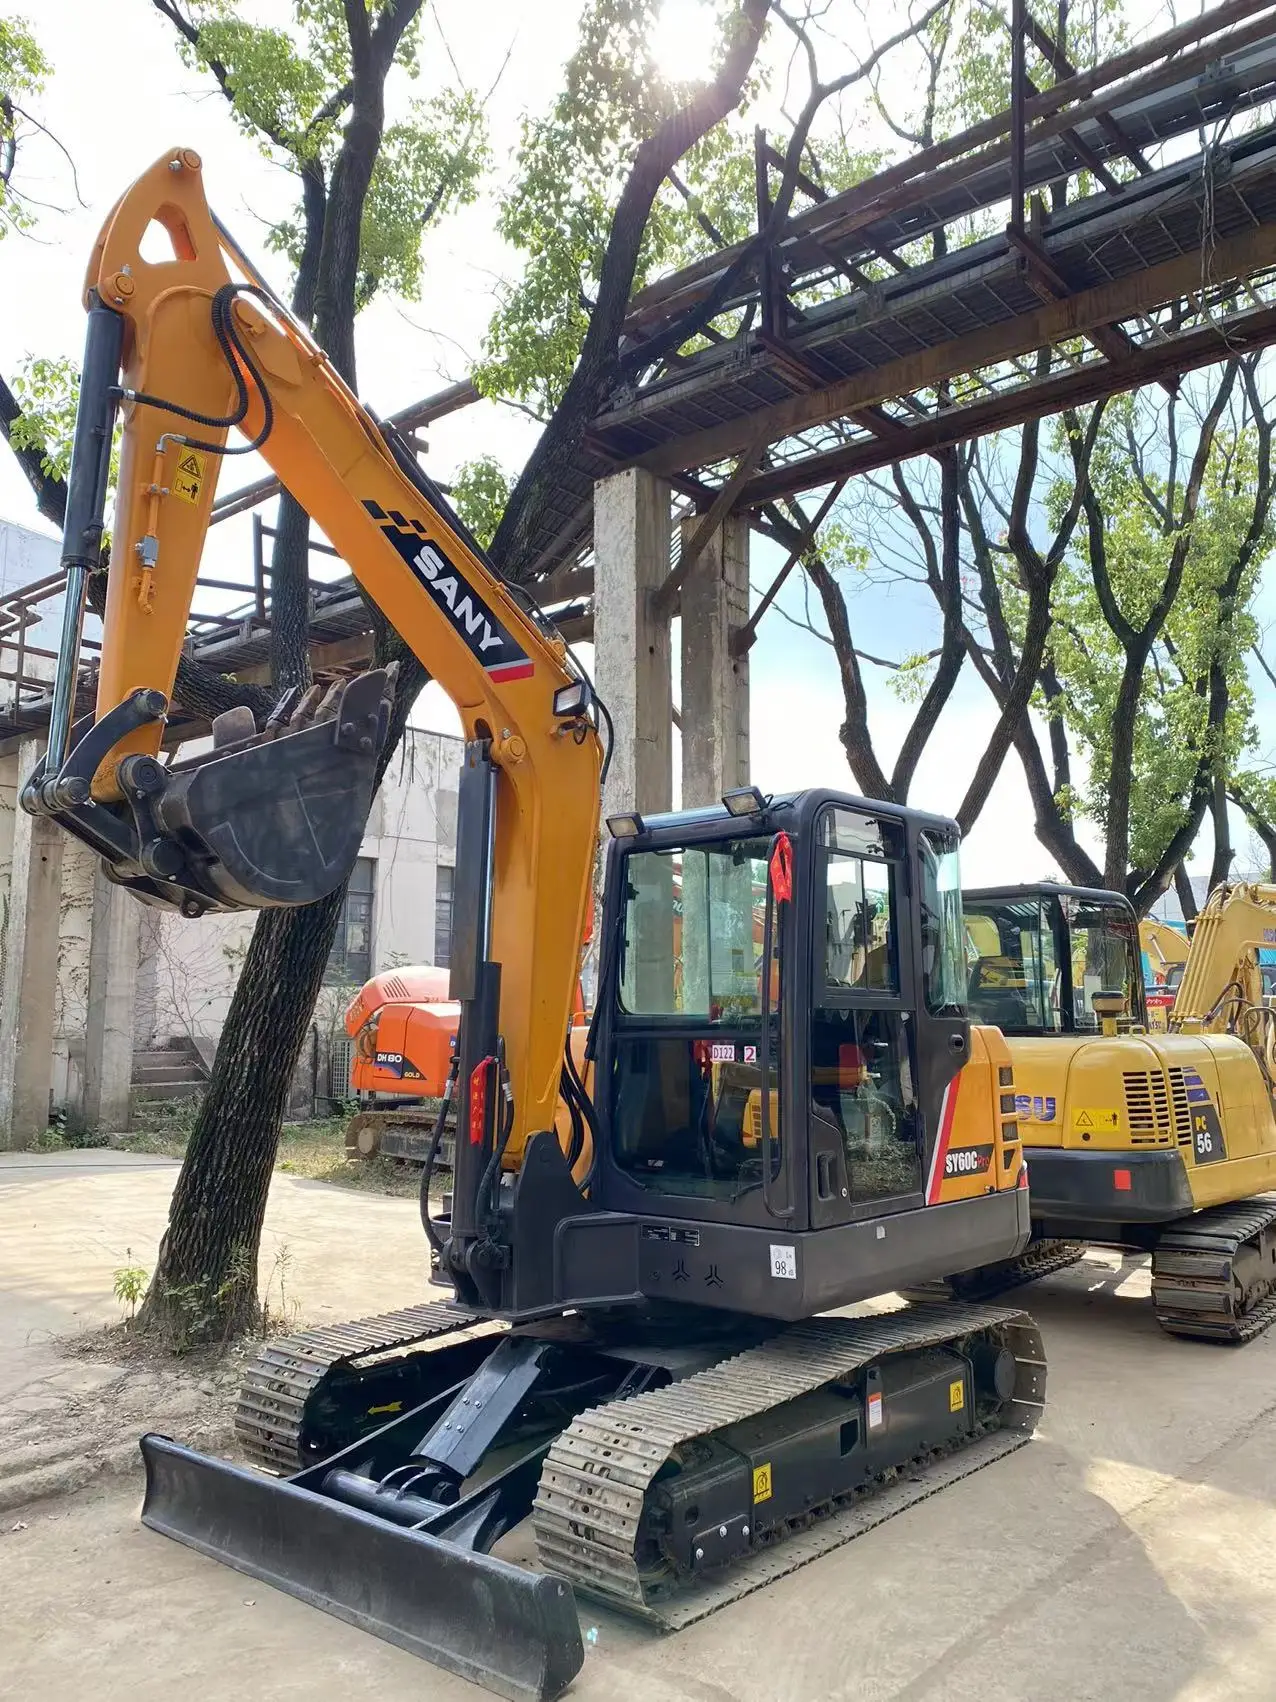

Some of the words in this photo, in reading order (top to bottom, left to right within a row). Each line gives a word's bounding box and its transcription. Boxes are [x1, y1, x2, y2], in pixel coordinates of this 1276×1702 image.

[412, 545, 504, 652] SANY
[713, 1047, 733, 1060] D122
[745, 1047, 755, 1062] 2
[1195, 1116, 1207, 1131] PC
[1197, 1132, 1212, 1154] 56
[775, 1260, 787, 1276] 98
